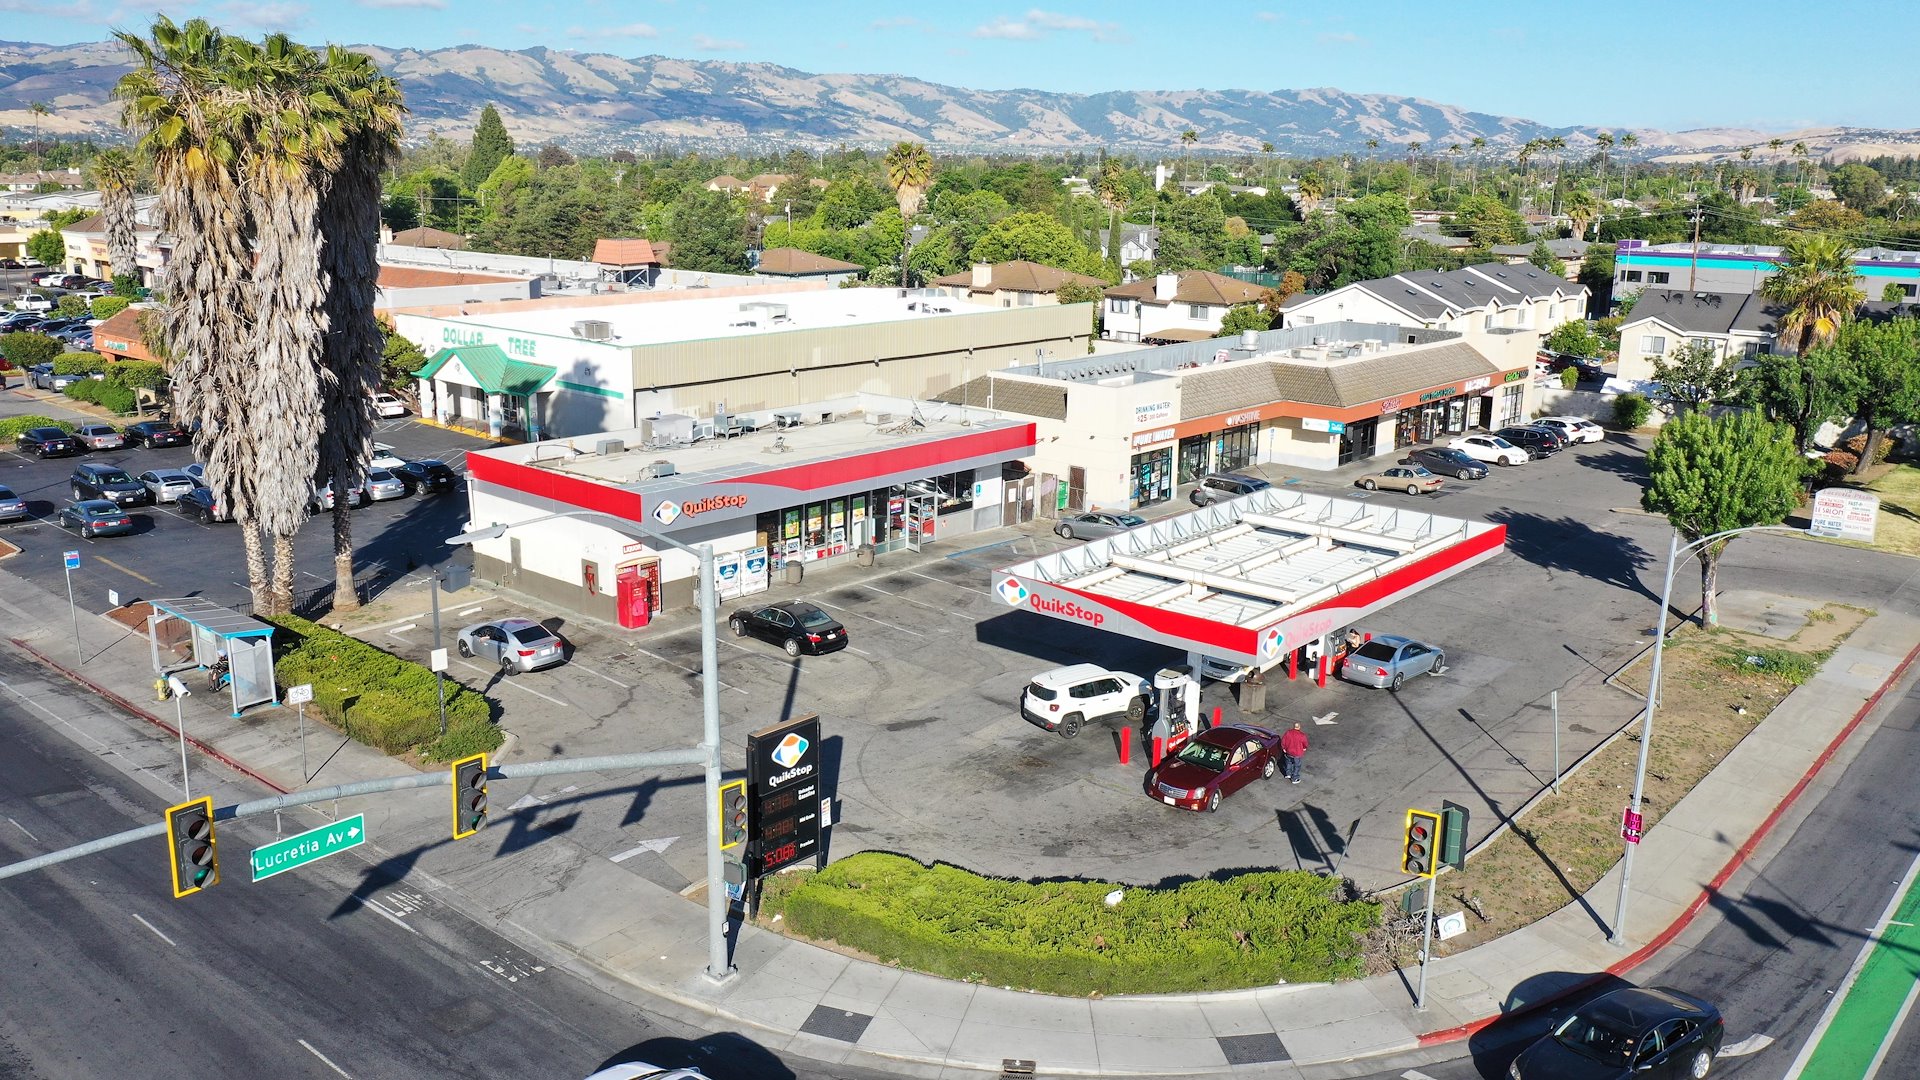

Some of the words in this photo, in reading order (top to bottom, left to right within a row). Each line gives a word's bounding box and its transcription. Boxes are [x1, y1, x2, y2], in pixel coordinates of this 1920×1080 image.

[443, 327, 484, 347] DOLLAR
[508, 337, 536, 357] TREE
[682, 495, 747, 518] QuikStop
[1030, 593, 1104, 626] QuikStop
[769, 764, 813, 787] QuikStop
[255, 841, 319, 872] Lucretia
[326, 832, 344, 847] Av
